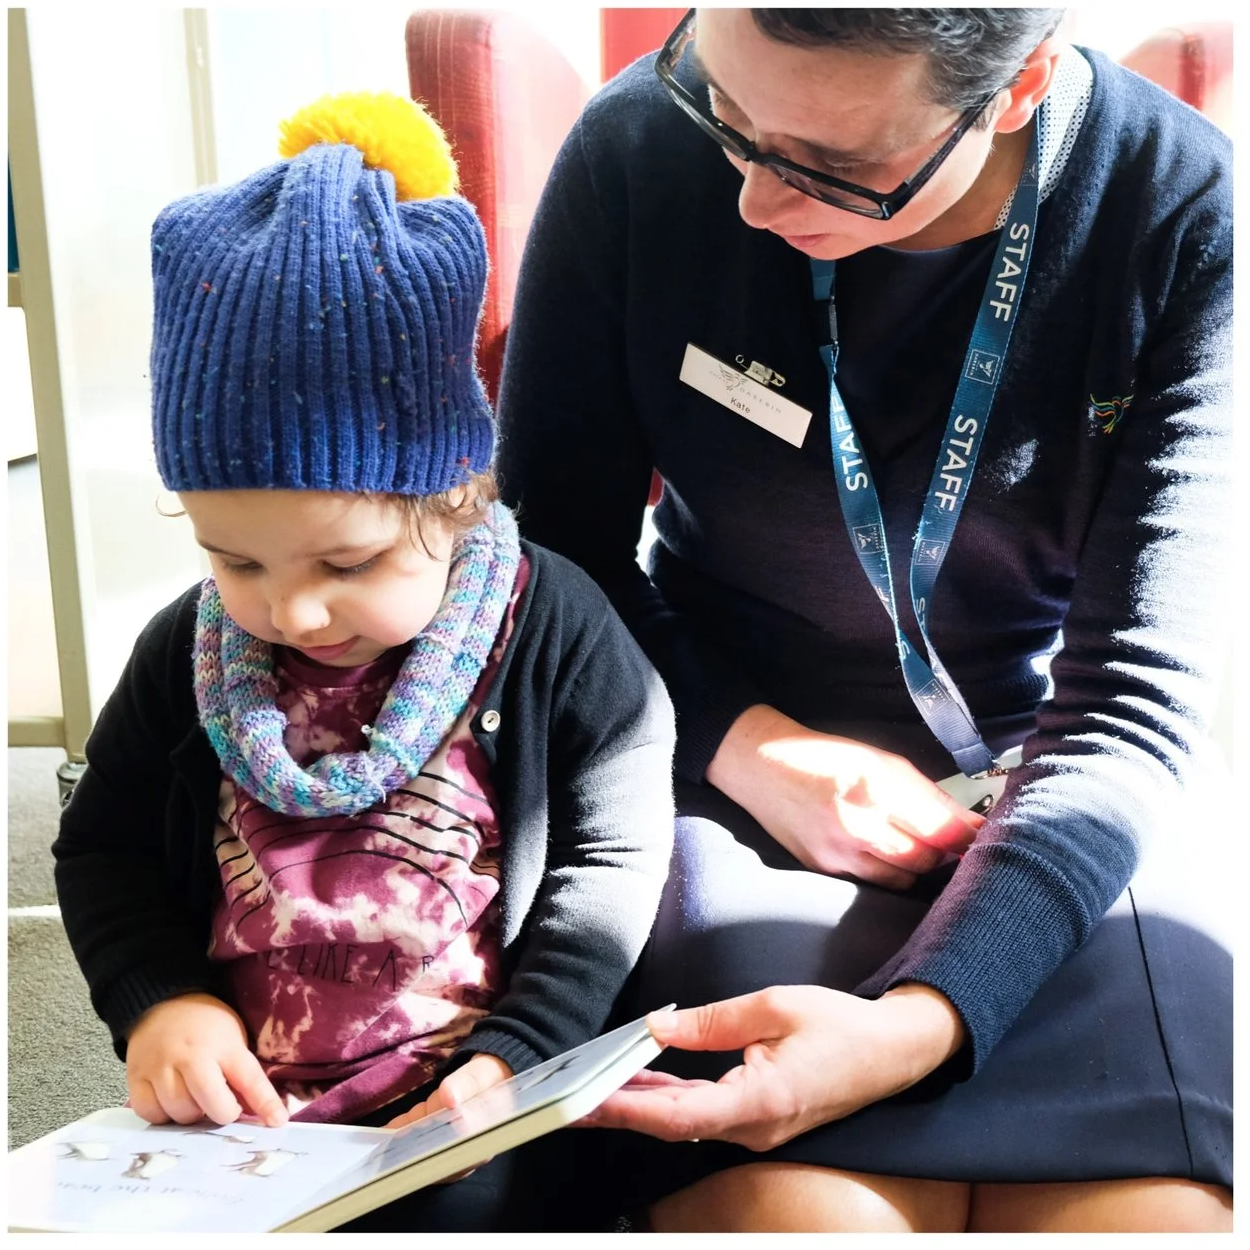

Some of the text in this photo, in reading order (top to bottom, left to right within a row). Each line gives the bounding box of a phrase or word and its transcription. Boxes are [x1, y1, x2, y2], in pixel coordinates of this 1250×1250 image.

[988, 222, 1030, 323] STAFF
[729, 396, 752, 415] Kate
[934, 415, 979, 513] STAFF
[296, 942, 358, 986] LIKE
